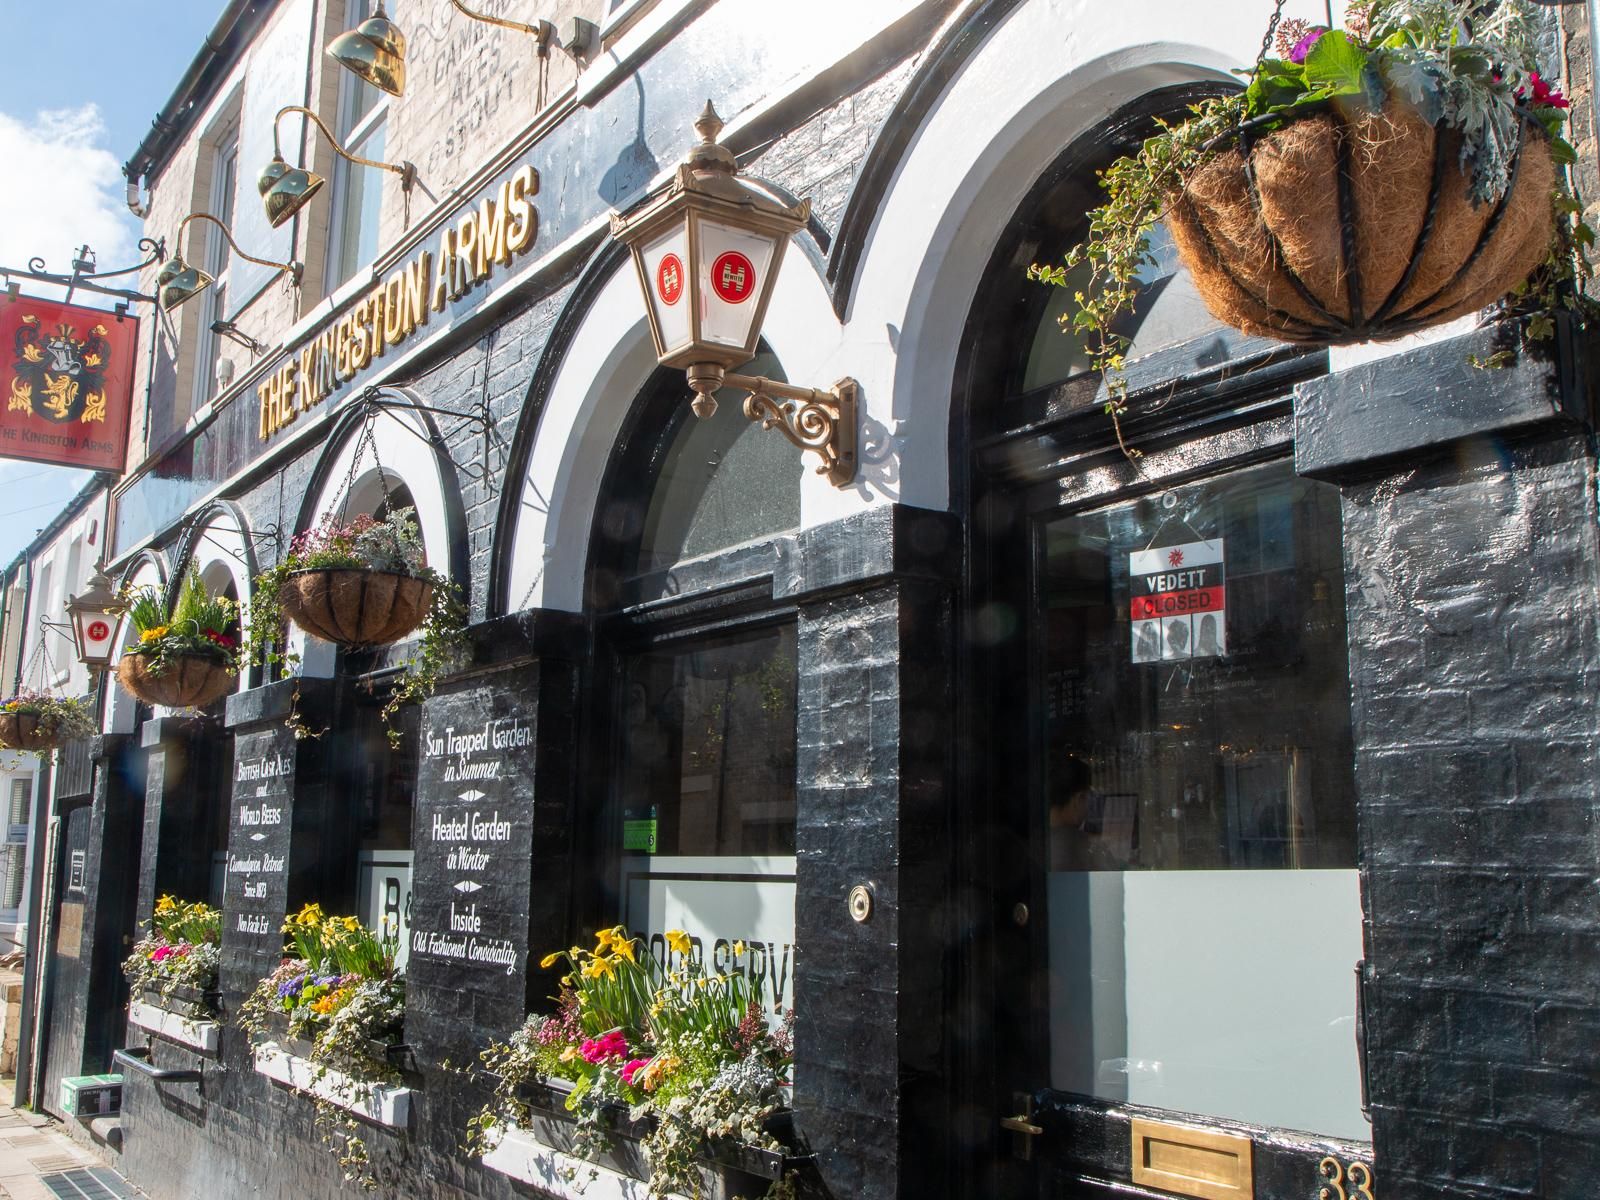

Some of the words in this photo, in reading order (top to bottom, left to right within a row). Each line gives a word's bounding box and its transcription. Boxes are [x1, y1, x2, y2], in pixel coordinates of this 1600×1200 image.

[446, 61, 518, 158] STOUT
[257, 358, 299, 441] THE
[299, 250, 431, 413] KINGSTON
[432, 164, 540, 313] ARMS
[22, 428, 77, 448] KINGSTON
[81, 437, 114, 453] ARMS
[1146, 569, 1206, 593] VEDETT
[1143, 591, 1211, 615] CLOSED
[425, 731, 443, 757] Sun
[445, 722, 489, 760] Trapped
[492, 718, 530, 750] Garden
[237, 762, 260, 782] BRITISH
[261, 756, 275, 778] CASK
[275, 753, 291, 776] ALES
[444, 760, 455, 781] in
[456, 757, 500, 781] Summer
[240, 805, 261, 826] WORLD
[261, 803, 281, 825] BEERS
[432, 812, 469, 841] Heated
[471, 810, 511, 841] Garden
[262, 853, 285, 872] Retreat
[447, 847, 457, 870] in
[458, 846, 489, 871] Winter
[450, 902, 481, 933] Inside
[413, 930, 427, 953] Old
[428, 932, 468, 959] Fashioned
[468, 937, 518, 976] Conviviality
[1319, 1156, 1374, 1200] 33
